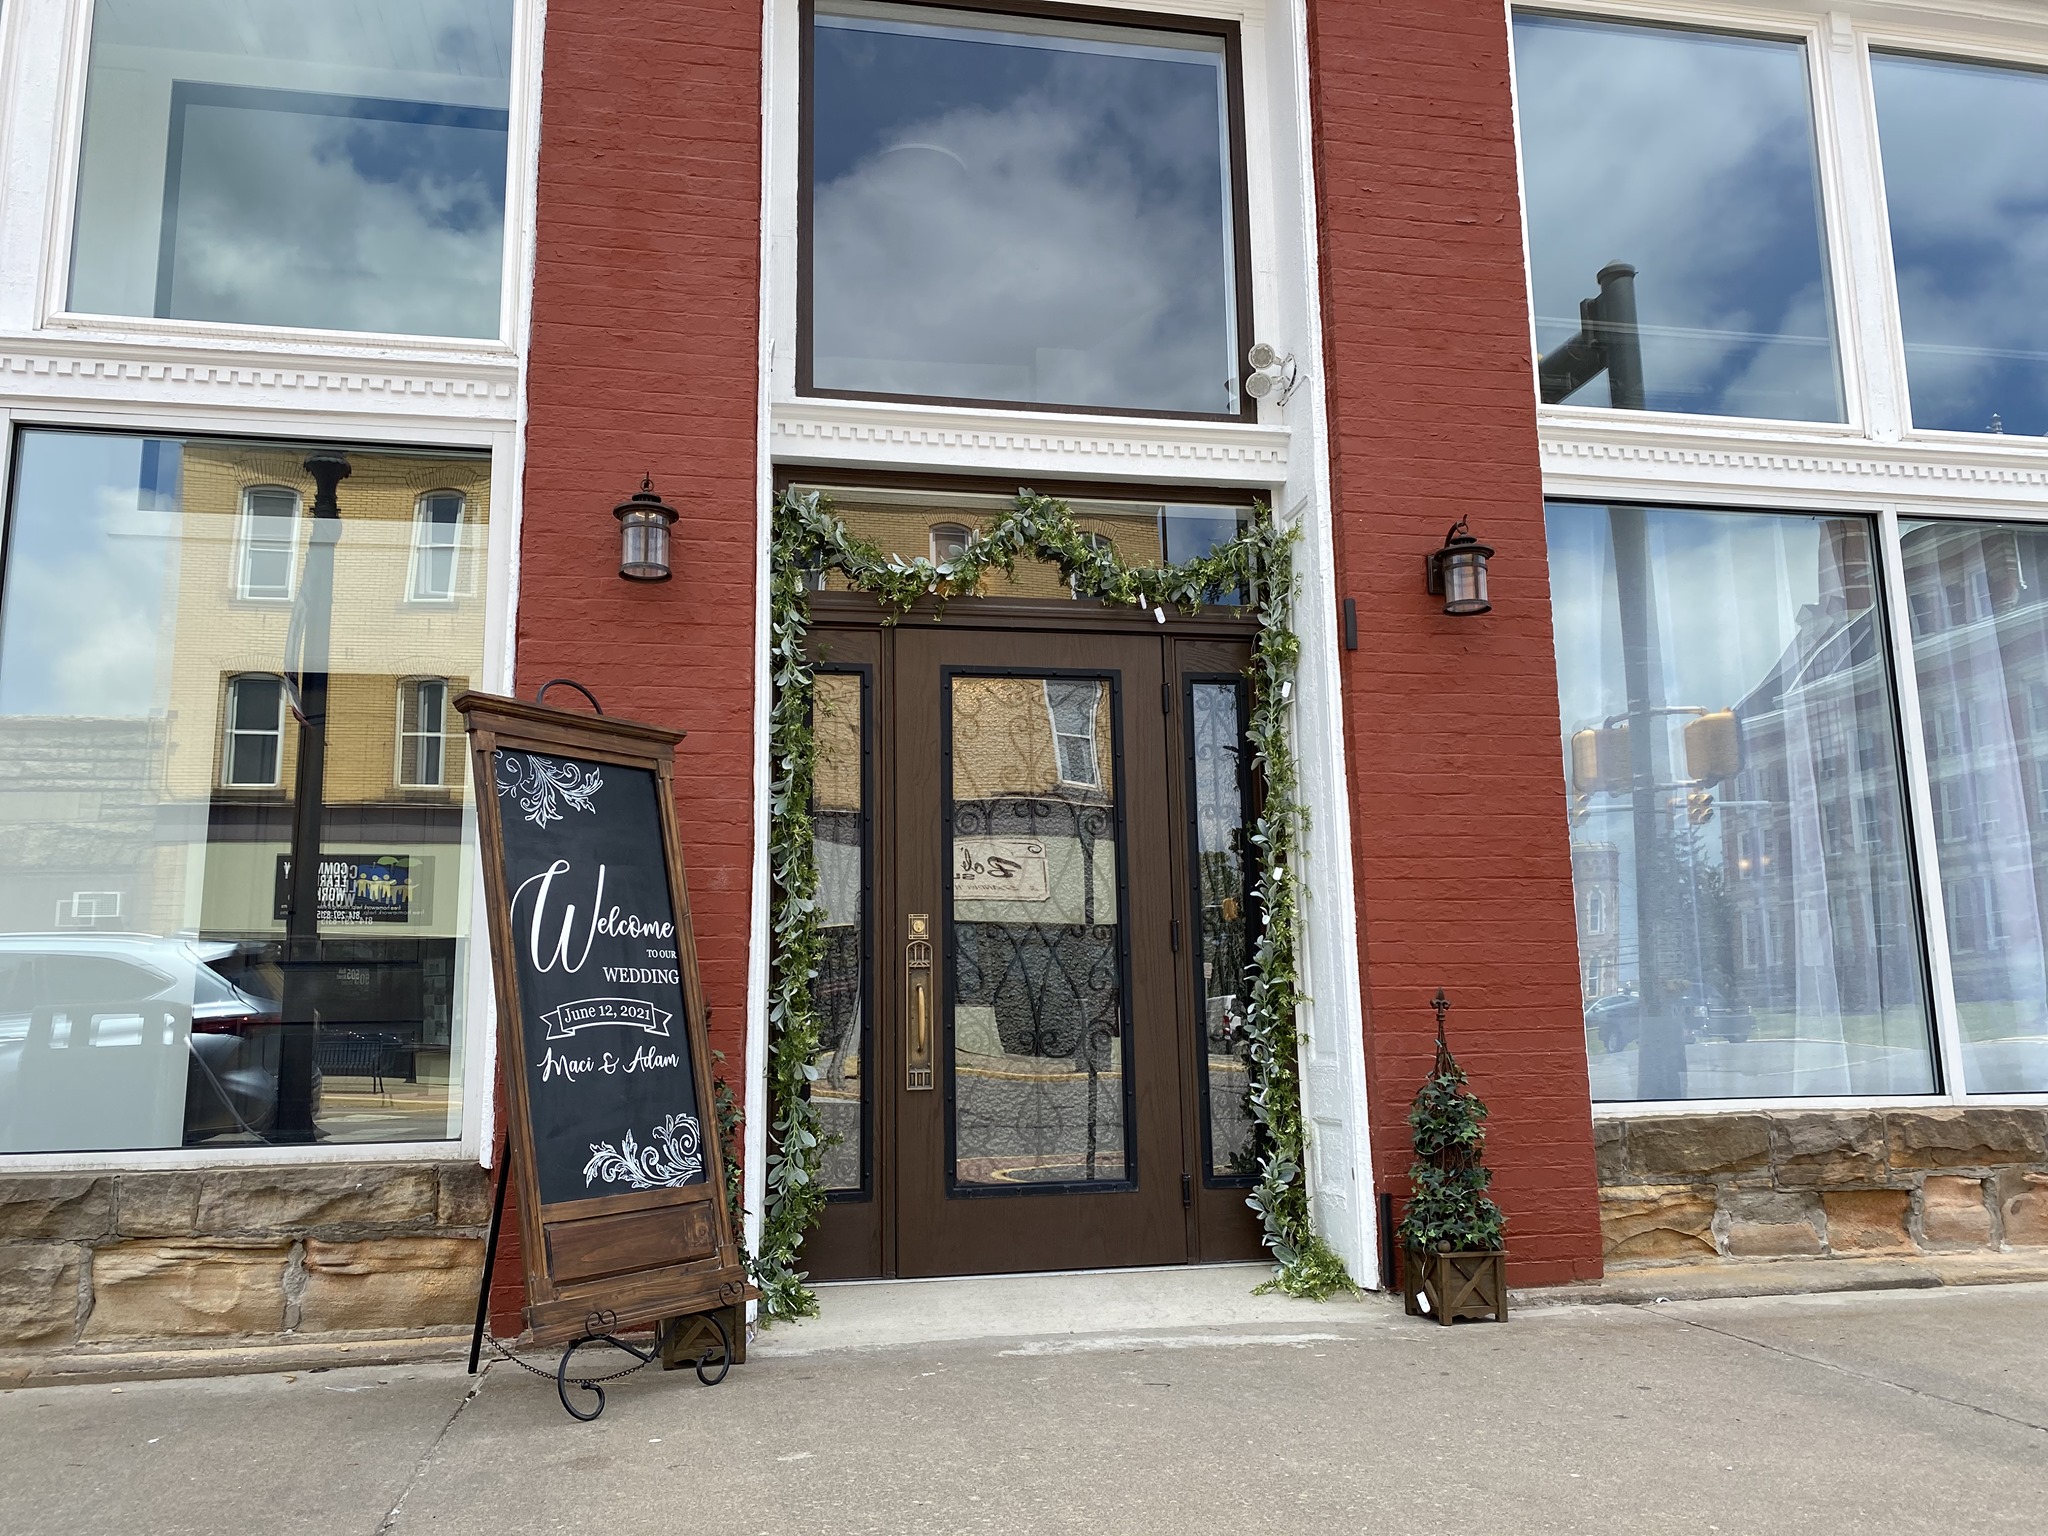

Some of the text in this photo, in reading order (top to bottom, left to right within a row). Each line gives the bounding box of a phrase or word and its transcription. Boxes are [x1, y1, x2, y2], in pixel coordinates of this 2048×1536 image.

[510, 859, 674, 973] Welcome
[646, 949, 677, 959] TO OUR
[602, 966, 679, 985] WEDDING
[564, 1004, 651, 1023] June 12, 2021
[537, 1045, 679, 1082] Maci & Adam
